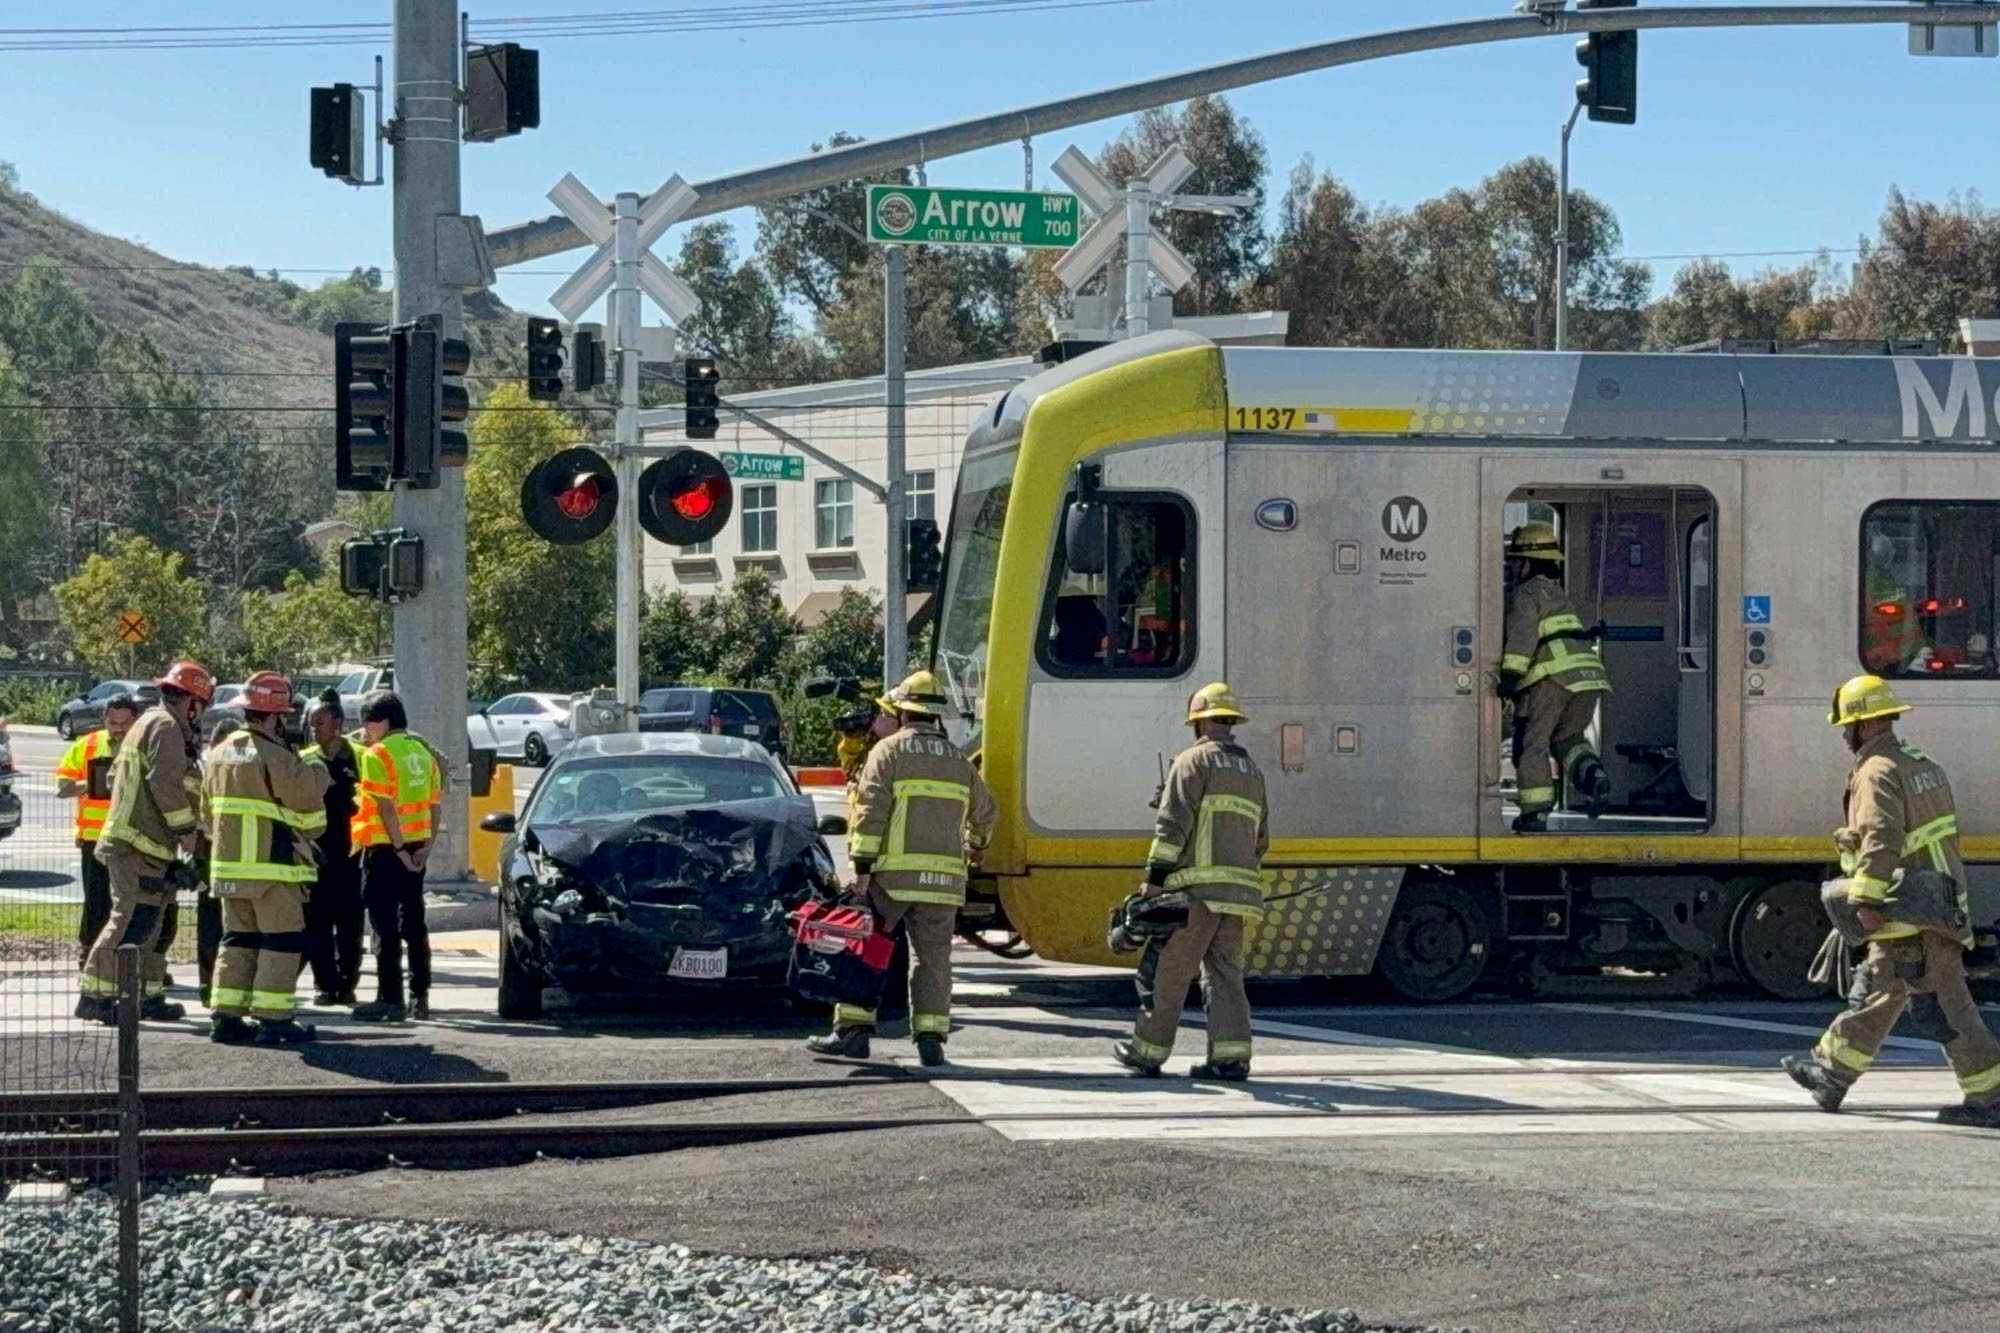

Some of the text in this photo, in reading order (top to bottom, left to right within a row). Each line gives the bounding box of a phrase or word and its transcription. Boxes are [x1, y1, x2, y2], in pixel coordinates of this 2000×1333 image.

[922, 191, 1026, 228] Arrow
[1043, 197, 1073, 214] HWY
[928, 229, 1022, 243] CITY OF LA VERNE
[1044, 220, 1071, 237] 700
[1892, 358, 2000, 437] M
[1236, 408, 1296, 430] 1137
[740, 454, 784, 472] Arrow
[1390, 504, 1421, 535] M
[1380, 547, 1427, 561] Metro
